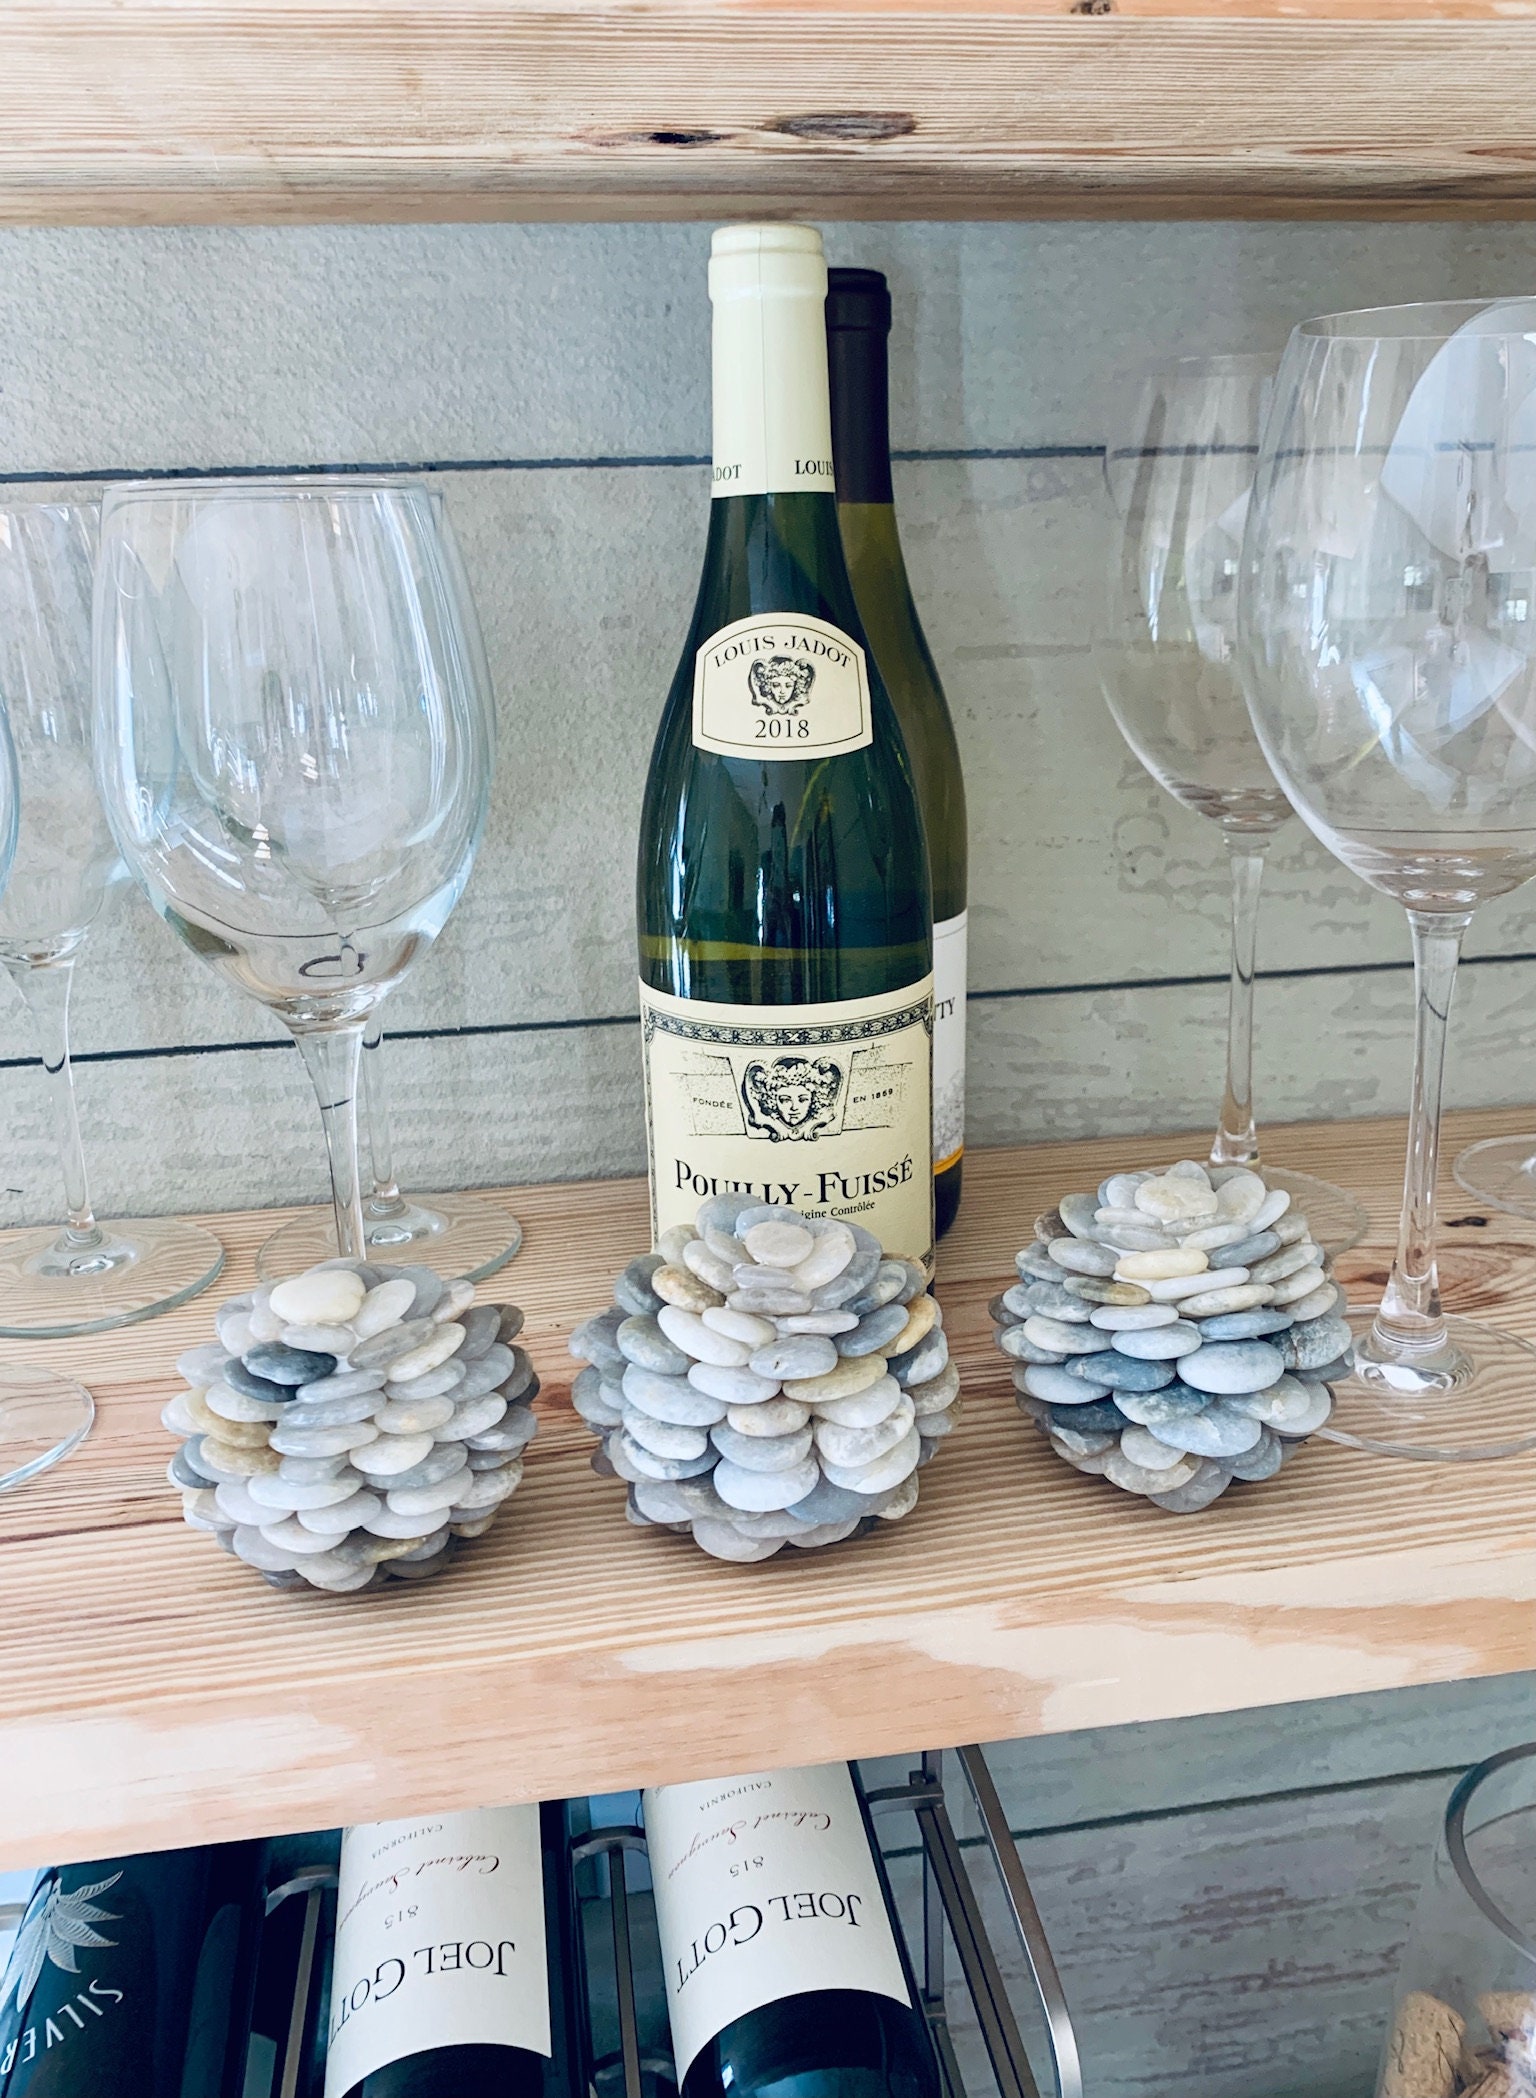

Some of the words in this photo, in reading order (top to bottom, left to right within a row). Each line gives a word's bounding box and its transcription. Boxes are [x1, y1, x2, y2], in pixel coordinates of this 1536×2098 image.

[714, 635, 775, 669] LOUIS
[784, 635, 851, 668] JADOT
[755, 719, 810, 739] 2018
[934, 996, 955, 1021] TY
[693, 1097, 733, 1110] FONDÉE
[853, 1095, 866, 1103] EN
[801, 1209, 827, 1220] igine
[830, 1200, 875, 1217] Contrôlée
[699, 1780, 772, 1811] CALIFORNIA
[753, 1812, 831, 1830] Cabernet
[372, 1824, 443, 1859] CALIFORNIA
[415, 1854, 500, 1876] Cabernet
[730, 1855, 764, 1878] 815
[384, 1905, 419, 1929] 815
[768, 1892, 862, 1927] JOEL
[413, 1941, 515, 1976] JOEL
[677, 1905, 763, 1993] GOTT
[329, 1958, 405, 2049] GOTT
[0, 1979, 123, 2075] SILVER
